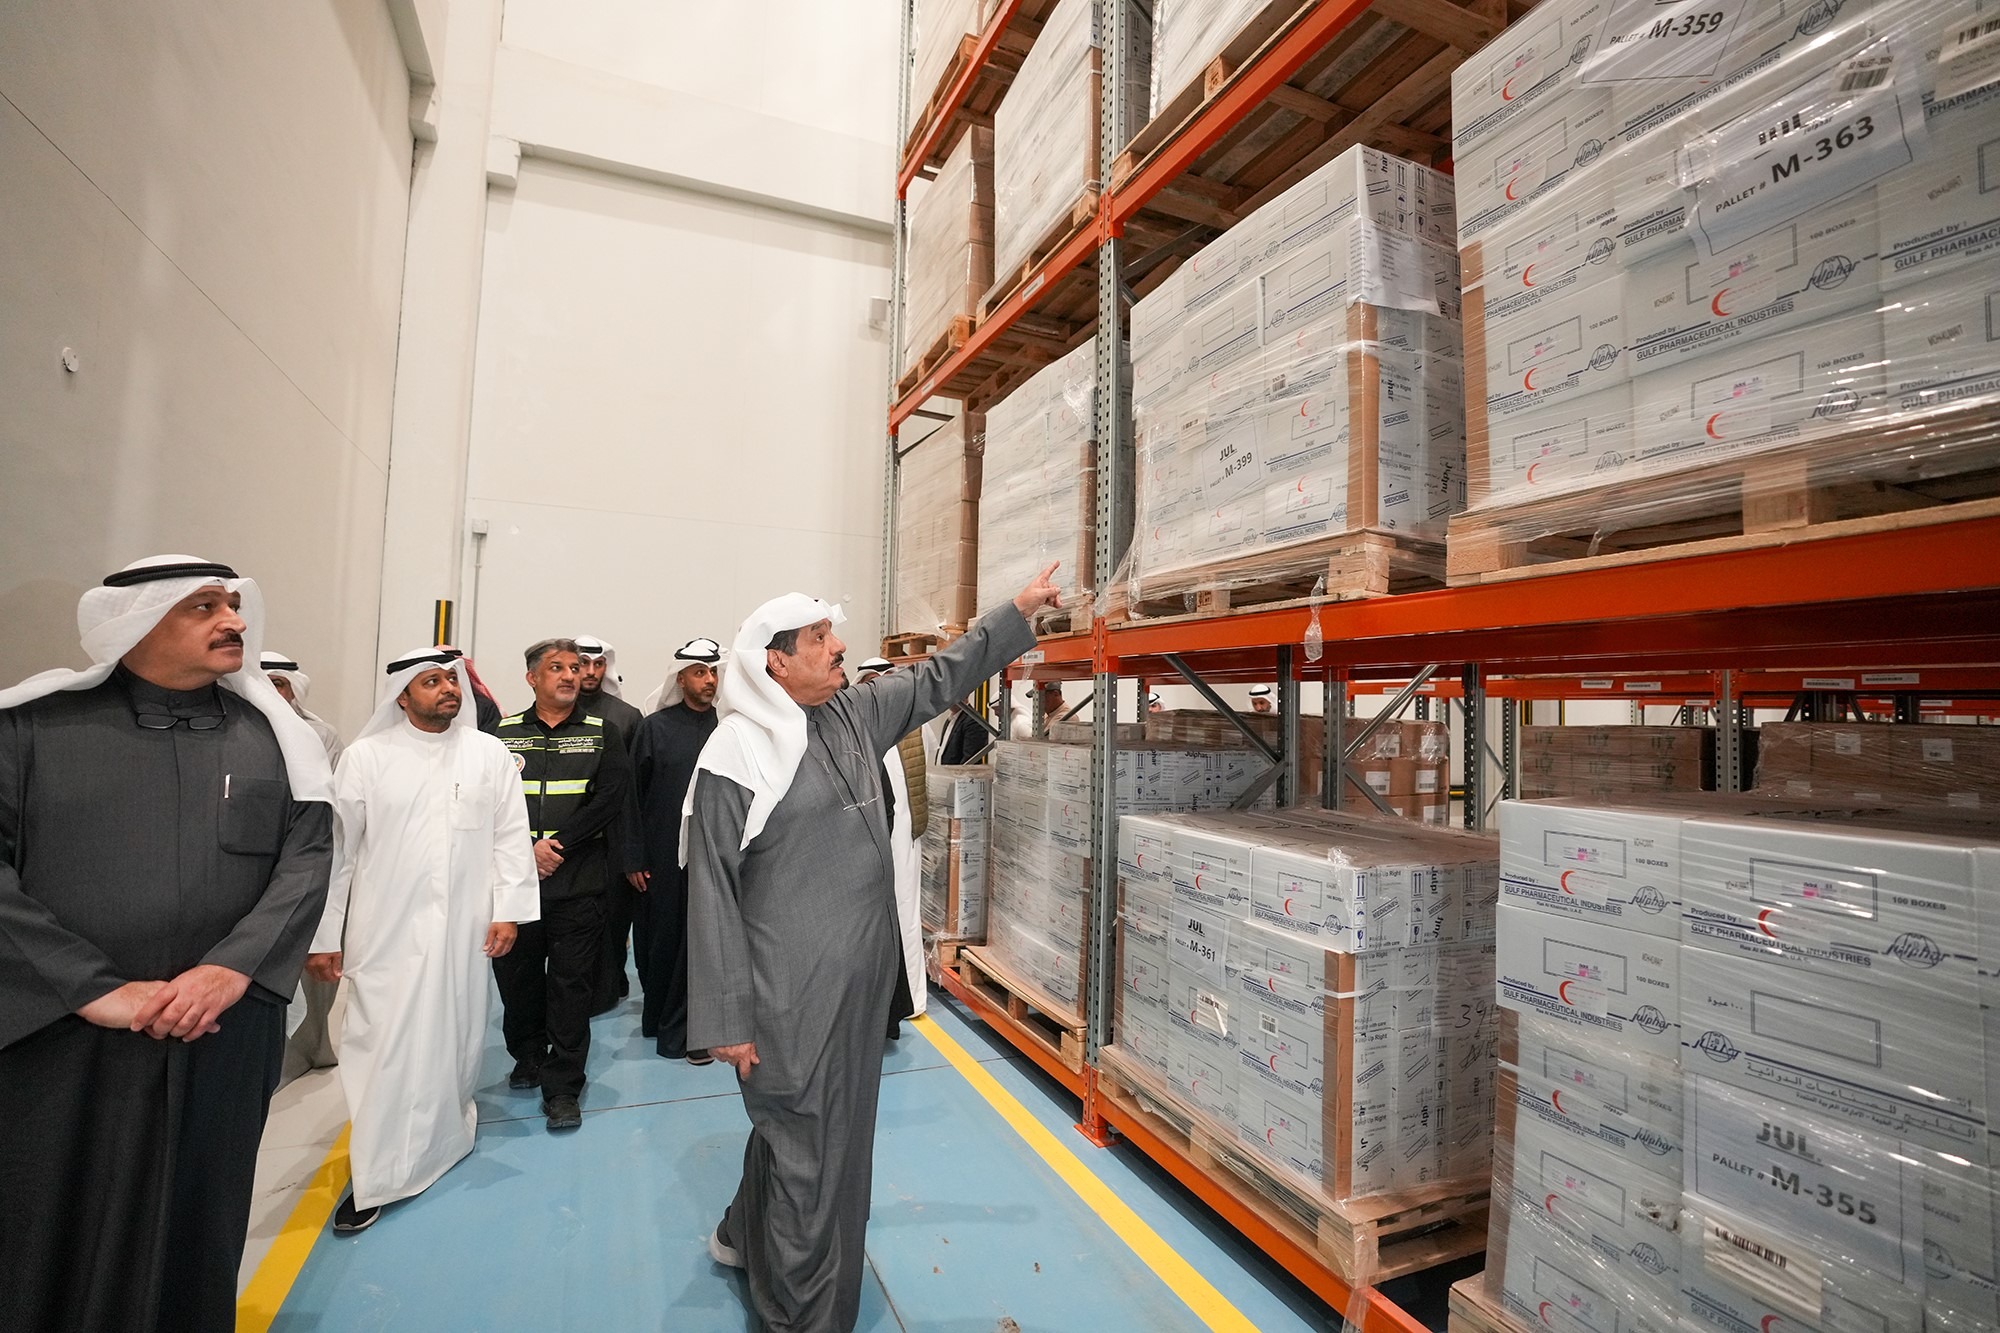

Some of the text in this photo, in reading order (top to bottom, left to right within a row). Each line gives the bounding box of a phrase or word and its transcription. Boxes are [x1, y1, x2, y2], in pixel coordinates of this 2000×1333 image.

[1609, 11, 1725, 45] PALLET M-359
[1626, 53, 1781, 143] GULF PHARMACEUTICAL INDUSTRIES
[1624, 102, 1665, 128] Produced by
[1715, 186, 1756, 214] PALLET
[1770, 115, 1875, 184] M-363
[1623, 208, 1666, 231] Produced by
[1809, 218, 1857, 241] 100 BOXES
[1624, 230, 1645, 246] GULF
[1893, 222, 1960, 250] Produced by
[1894, 251, 1928, 270] GULF
[1800, 261, 1862, 292] Julphar
[1486, 291, 1538, 318] PHARMACEUTICAL
[1538, 274, 1577, 297] INDUSTRIES
[1635, 326, 1677, 344] Produced by
[1636, 301, 1795, 360] GULF PHARMACEUTICAL INDUSTRIES
[1817, 352, 1865, 369] 100 BOXES
[1901, 395, 1935, 410] GULF
[1224, 452, 1253, 478] M-399
[1635, 857, 1669, 868] 100 BOXES
[1504, 885, 1622, 915] GULF PHARMACEUTICAL INDUSTRIES
[1628, 895, 1671, 910] Julphar
[1893, 895, 1947, 911] 100 BOXES
[1690, 907, 1737, 923] Produced by
[1189, 940, 1216, 962] M-361
[1691, 923, 1872, 967] GULF PHARMACEUTICAL INDUSTRIES
[1503, 975, 1535, 991] Produced by
[1636, 975, 1670, 989] 100 BOXES
[1503, 988, 1623, 1031] GULF PHARMACEUTICAL INDUSTRIES
[1628, 1013, 1672, 1031] Julphar
[1712, 1153, 1754, 1177] PALLET
[1771, 1164, 1878, 1225] M-355
[1690, 1303, 1716, 1321] GULF
